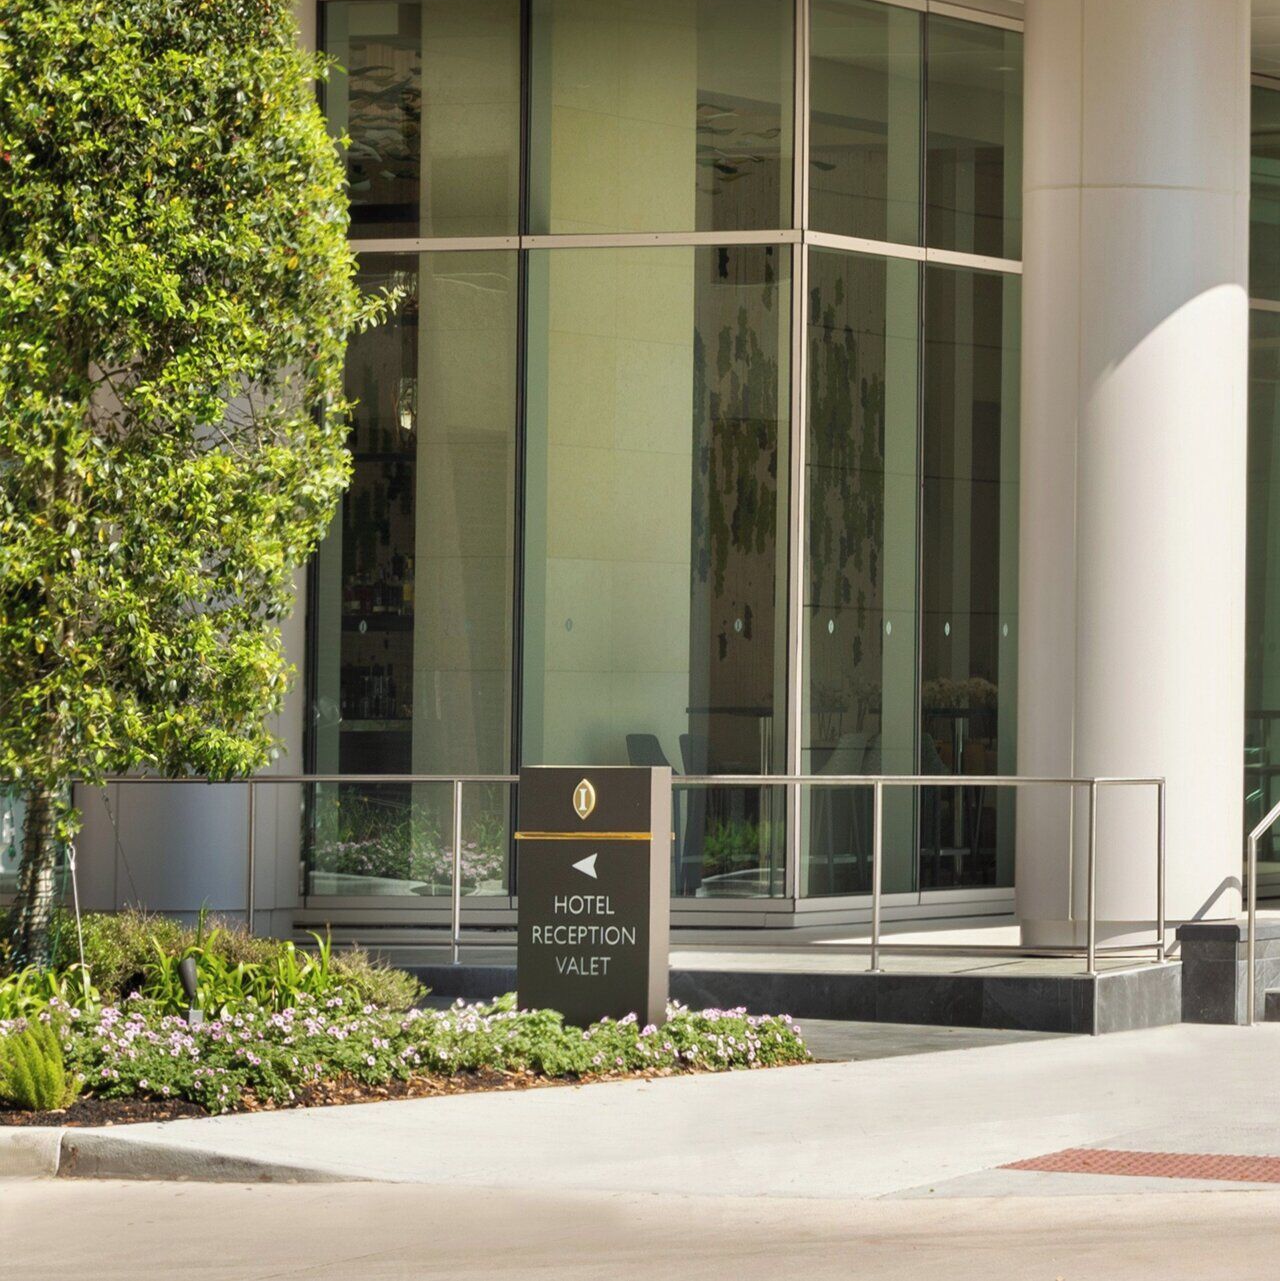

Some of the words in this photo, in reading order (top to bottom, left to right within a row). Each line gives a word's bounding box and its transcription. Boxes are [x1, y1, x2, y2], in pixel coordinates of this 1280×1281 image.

[554, 894, 615, 915] HOTEL
[531, 925, 637, 946] RECEPTION
[555, 956, 611, 976] VALET
